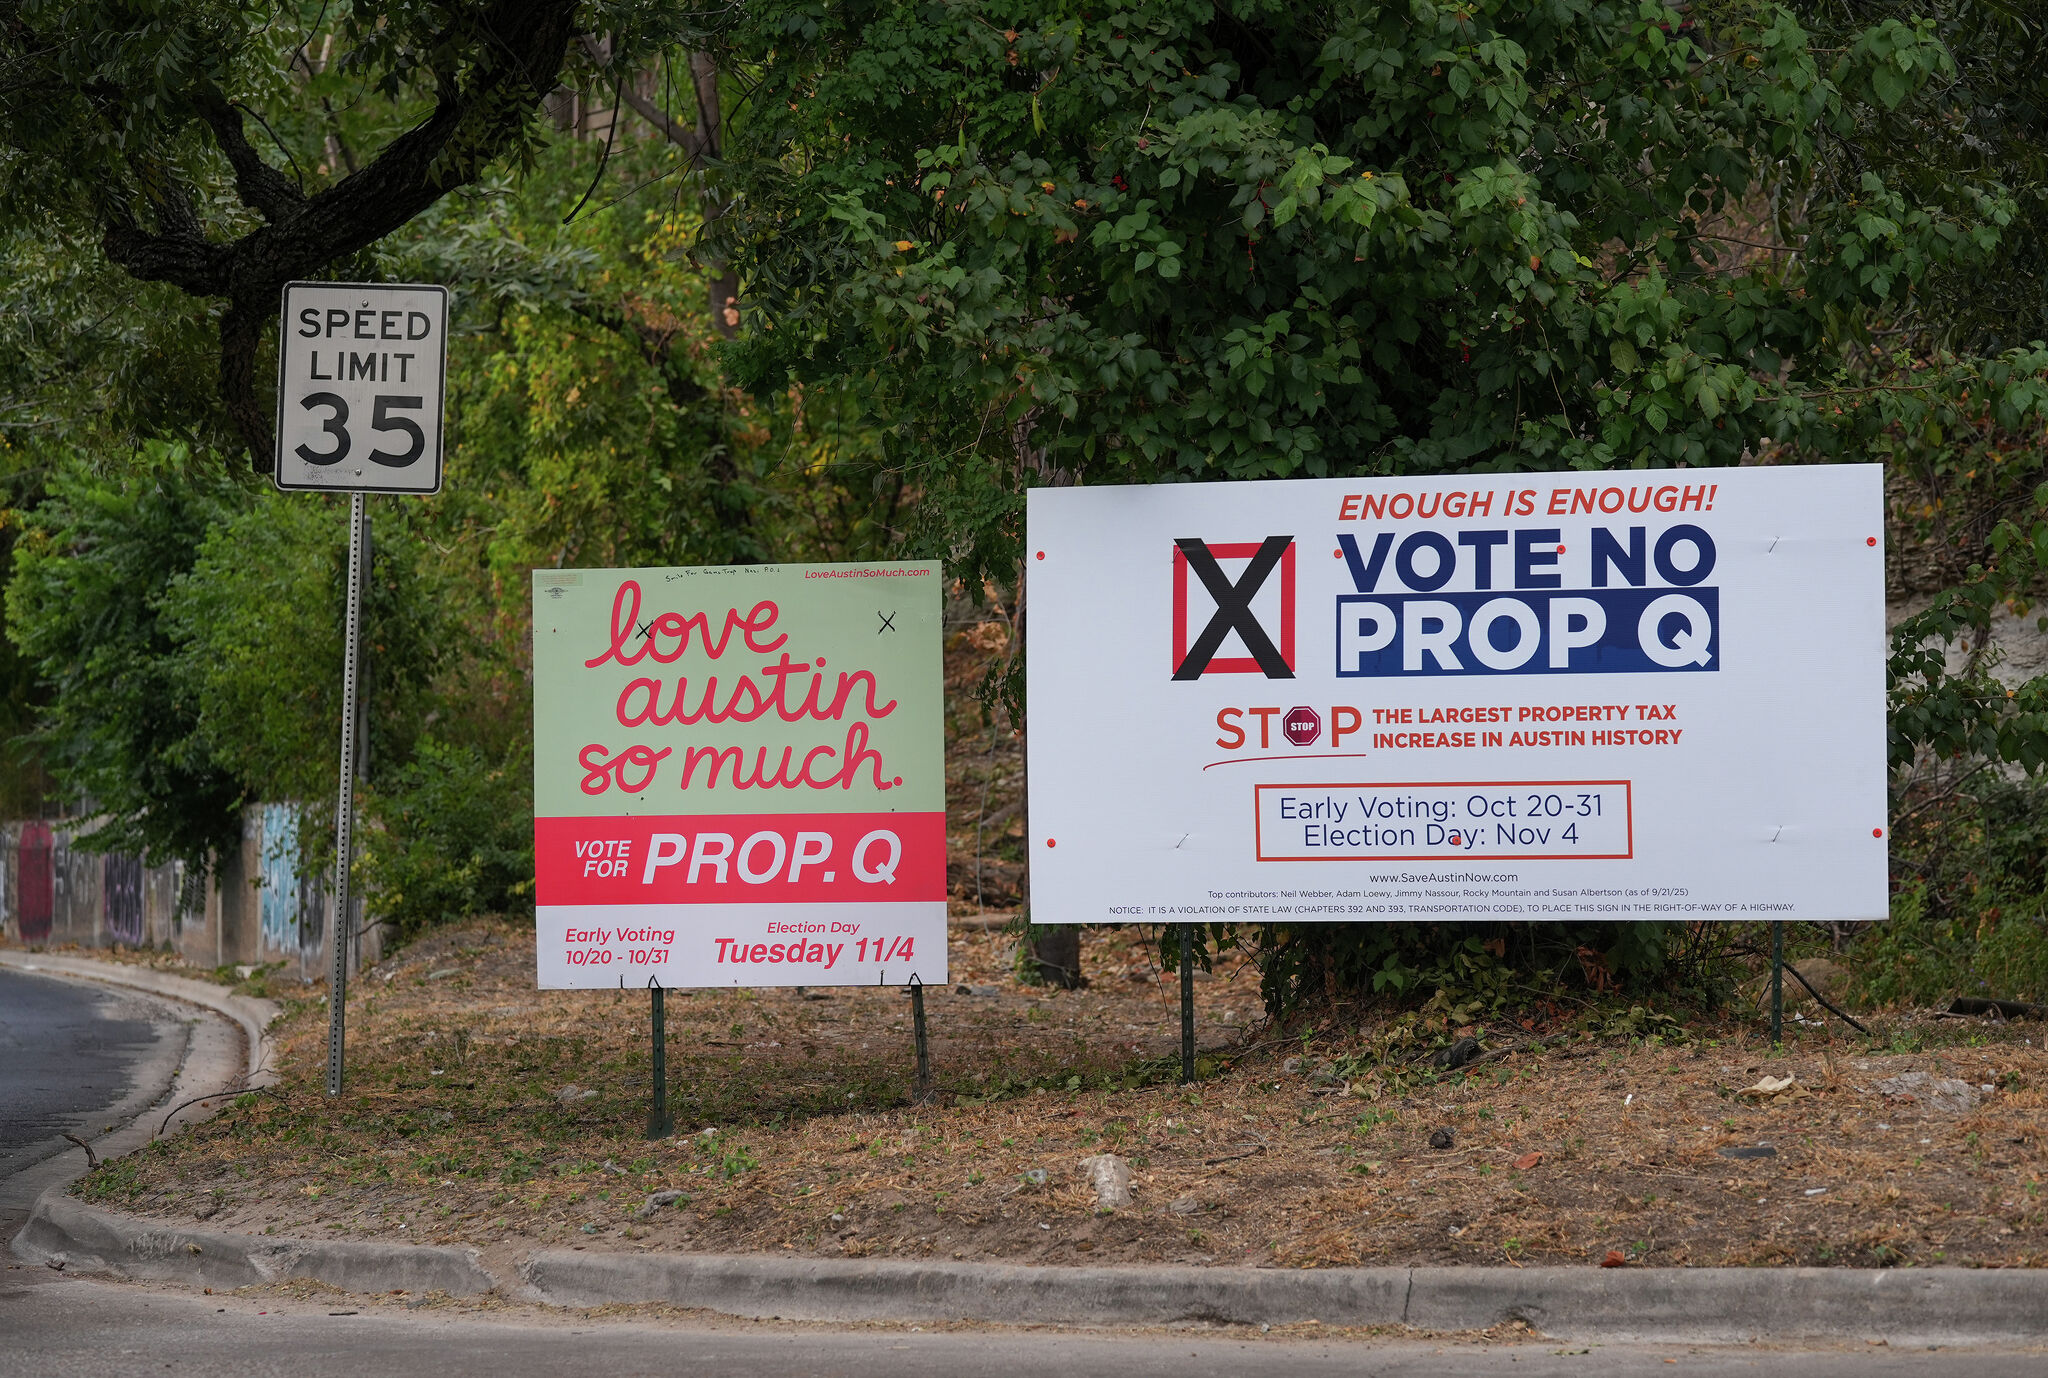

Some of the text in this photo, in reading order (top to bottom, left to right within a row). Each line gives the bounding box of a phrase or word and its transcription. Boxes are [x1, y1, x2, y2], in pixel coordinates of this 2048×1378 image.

[298, 308, 430, 340] SPEED
[311, 351, 415, 382] LIMIT
[294, 392, 425, 468] 35
[1338, 484, 1718, 521] ENOUGH IS ENOUGH!
[1336, 523, 1717, 593] VOTE NO
[805, 568, 930, 579] LoveAustinSoMuch.com
[584, 580, 789, 669] love
[1339, 593, 1713, 672] PROP Q
[616, 652, 898, 728] austin
[1290, 722, 1315, 732] STOP
[1373, 705, 1677, 724] THE LARGEST PROPERTY TAX
[1373, 729, 1683, 749] INCREASE IN AUSTIN HISTORY
[578, 721, 903, 796] so much.
[1280, 793, 1602, 823] Early Voting: Oct 20-31
[575, 840, 632, 858] VOTE
[1304, 822, 1579, 850] Election Day: Nov 4
[583, 859, 629, 878] FOR
[642, 829, 903, 885] PROP. Q
[1370, 872, 1518, 883] www.SaveAustinNow.com
[1208, 890, 1223, 899] Top
[1225, 890, 1279, 898] contributors:
[1281, 890, 1296, 898] Neil
[1300, 890, 1334, 898] Webber,
[1363, 890, 1392, 898] Loewy,
[1394, 889, 1422, 898] Jimmy
[1425, 889, 1461, 897] Nassour,
[1463, 889, 1489, 898] Rocky
[1492, 889, 1531, 897] Mountain
[1625, 888, 1638, 897] (as
[1640, 888, 1650, 896] of
[1651, 888, 1689, 897] 9/21/25)
[1109, 906, 1144, 914] NOTICE:
[1148, 906, 1156, 914] IT
[1158, 906, 1167, 914] IS
[1169, 906, 1176, 914] A
[1178, 906, 1225, 914] VIOLATION
[1272, 905, 1292, 913] LAW
[1294, 905, 1345, 914] (CHAPTERS
[1347, 905, 1363, 913] 392
[1366, 905, 1385, 913] AND
[1388, 905, 1406, 914] 393,
[1409, 905, 1490, 913] TRANSPORTATION
[1493, 904, 1525, 913] CODE),
[1527, 904, 1539, 912] TO
[1542, 904, 1571, 912] PLACE
[1574, 904, 1594, 912] THIS
[1597, 904, 1618, 912] SIGN
[1621, 904, 1630, 912] IN
[1633, 904, 1651, 912] THE
[1653, 904, 1722, 912] RIGHT-OF-WAY
[1724, 904, 1737, 912] OF
[1750, 904, 1796, 912] HIGHWAY.
[565, 927, 675, 945] Early Voting
[767, 921, 860, 937] Election Day
[565, 949, 612, 966] 10/20
[628, 949, 670, 965] 10/31
[714, 936, 915, 969] Tuesday 11/4
